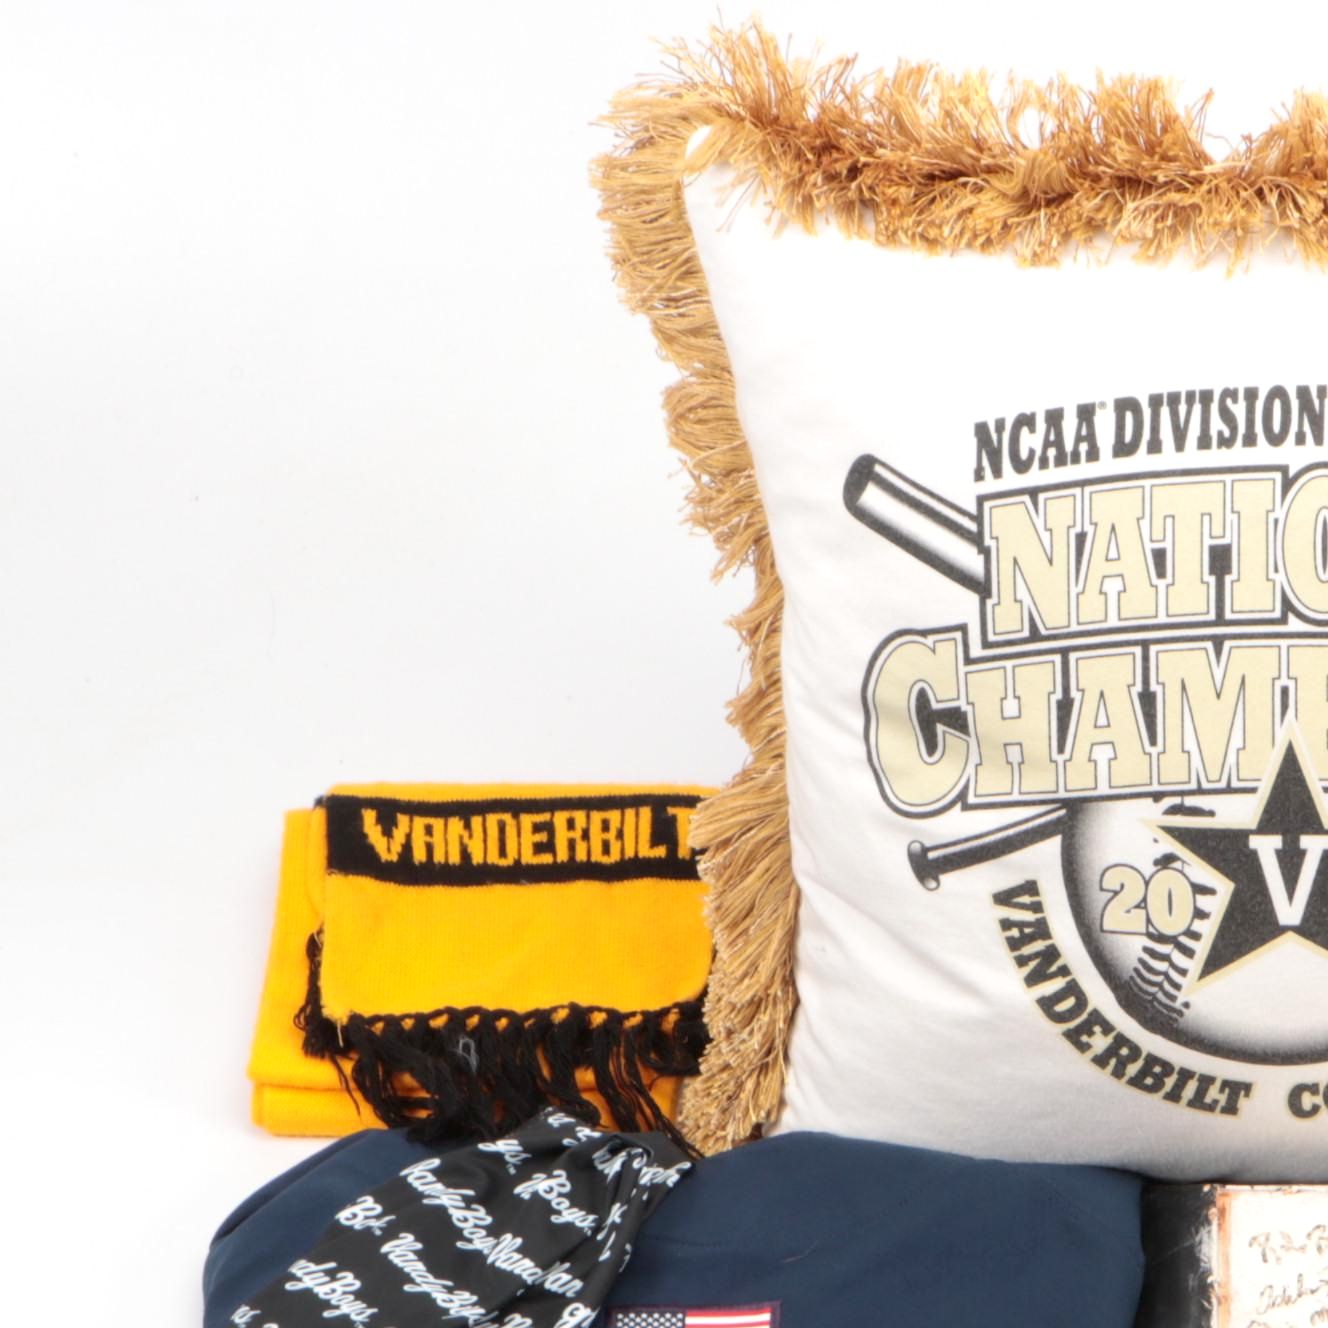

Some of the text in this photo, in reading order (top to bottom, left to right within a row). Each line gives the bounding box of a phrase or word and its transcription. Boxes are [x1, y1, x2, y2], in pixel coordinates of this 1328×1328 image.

[974, 403, 1100, 481] NCAA
[1112, 386, 1328, 459] DIVISION
[362, 806, 700, 867] VANDERBILT
[991, 877, 1253, 1119] VANDERBILT
